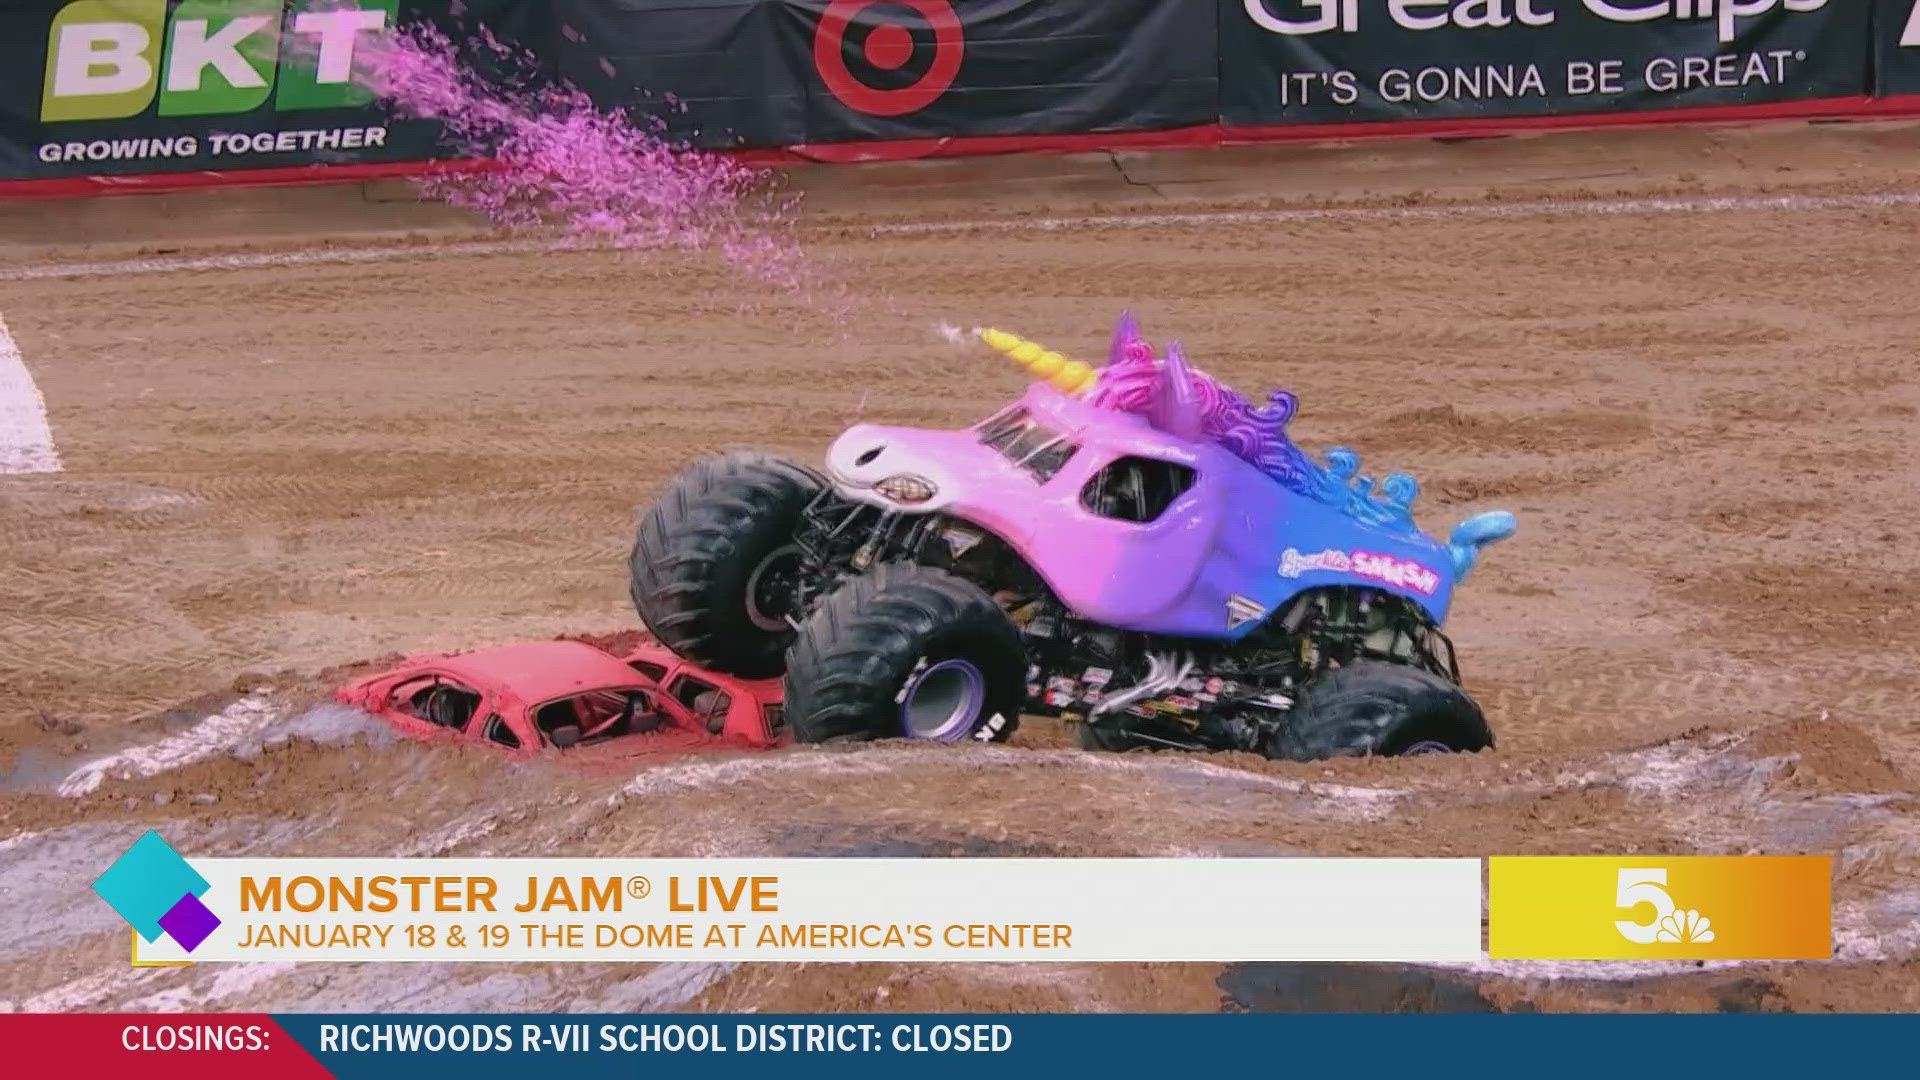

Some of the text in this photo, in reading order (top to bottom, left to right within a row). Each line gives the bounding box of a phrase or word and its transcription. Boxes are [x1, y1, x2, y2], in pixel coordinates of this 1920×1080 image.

[53, 9, 387, 97] BKT
[1280, 71, 1358, 106] IT'S
[1379, 64, 1546, 102] GONNA
[1567, 60, 1624, 95] BE
[39, 127, 387, 162] GROWING TOGETHER
